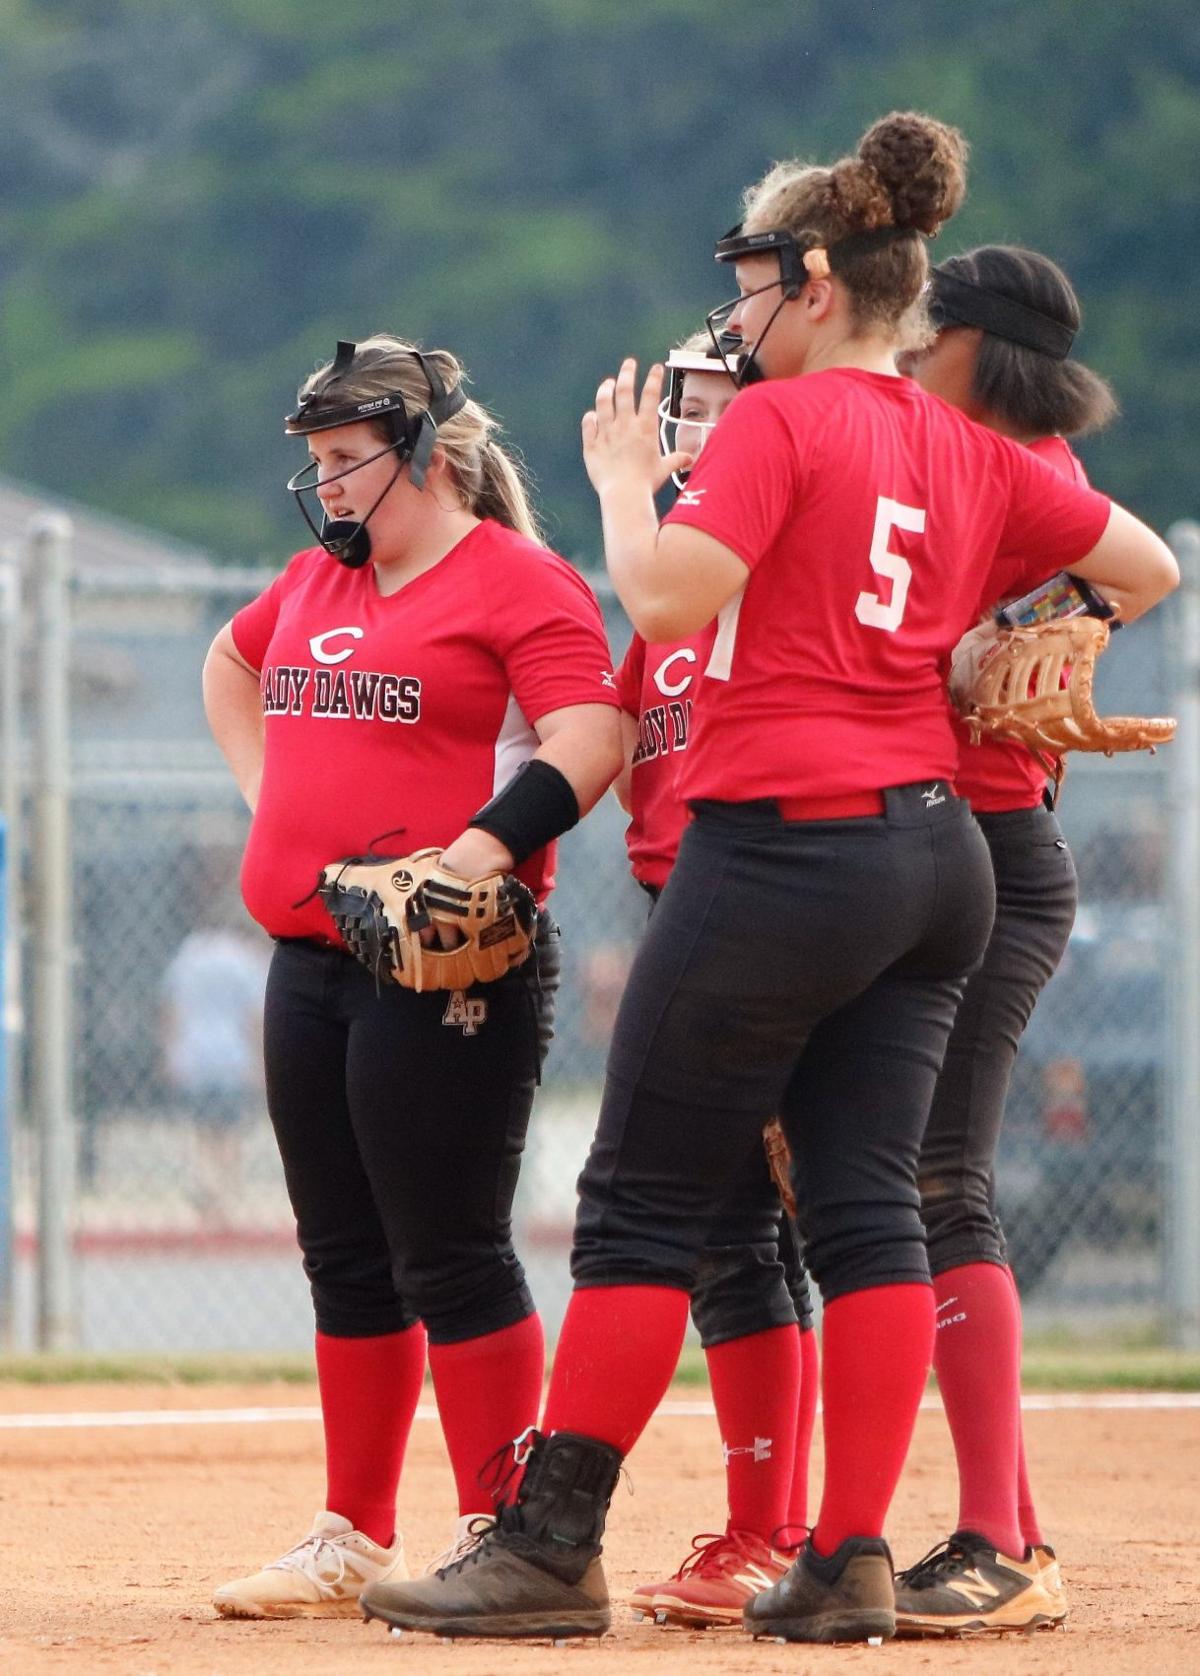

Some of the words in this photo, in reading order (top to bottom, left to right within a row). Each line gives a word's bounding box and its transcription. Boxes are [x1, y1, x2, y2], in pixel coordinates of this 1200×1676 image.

[854, 495, 927, 633] 5
[308, 626, 364, 665] C
[653, 647, 697, 697] C
[262, 666, 311, 716] ADY
[311, 670, 422, 724] DAWGS
